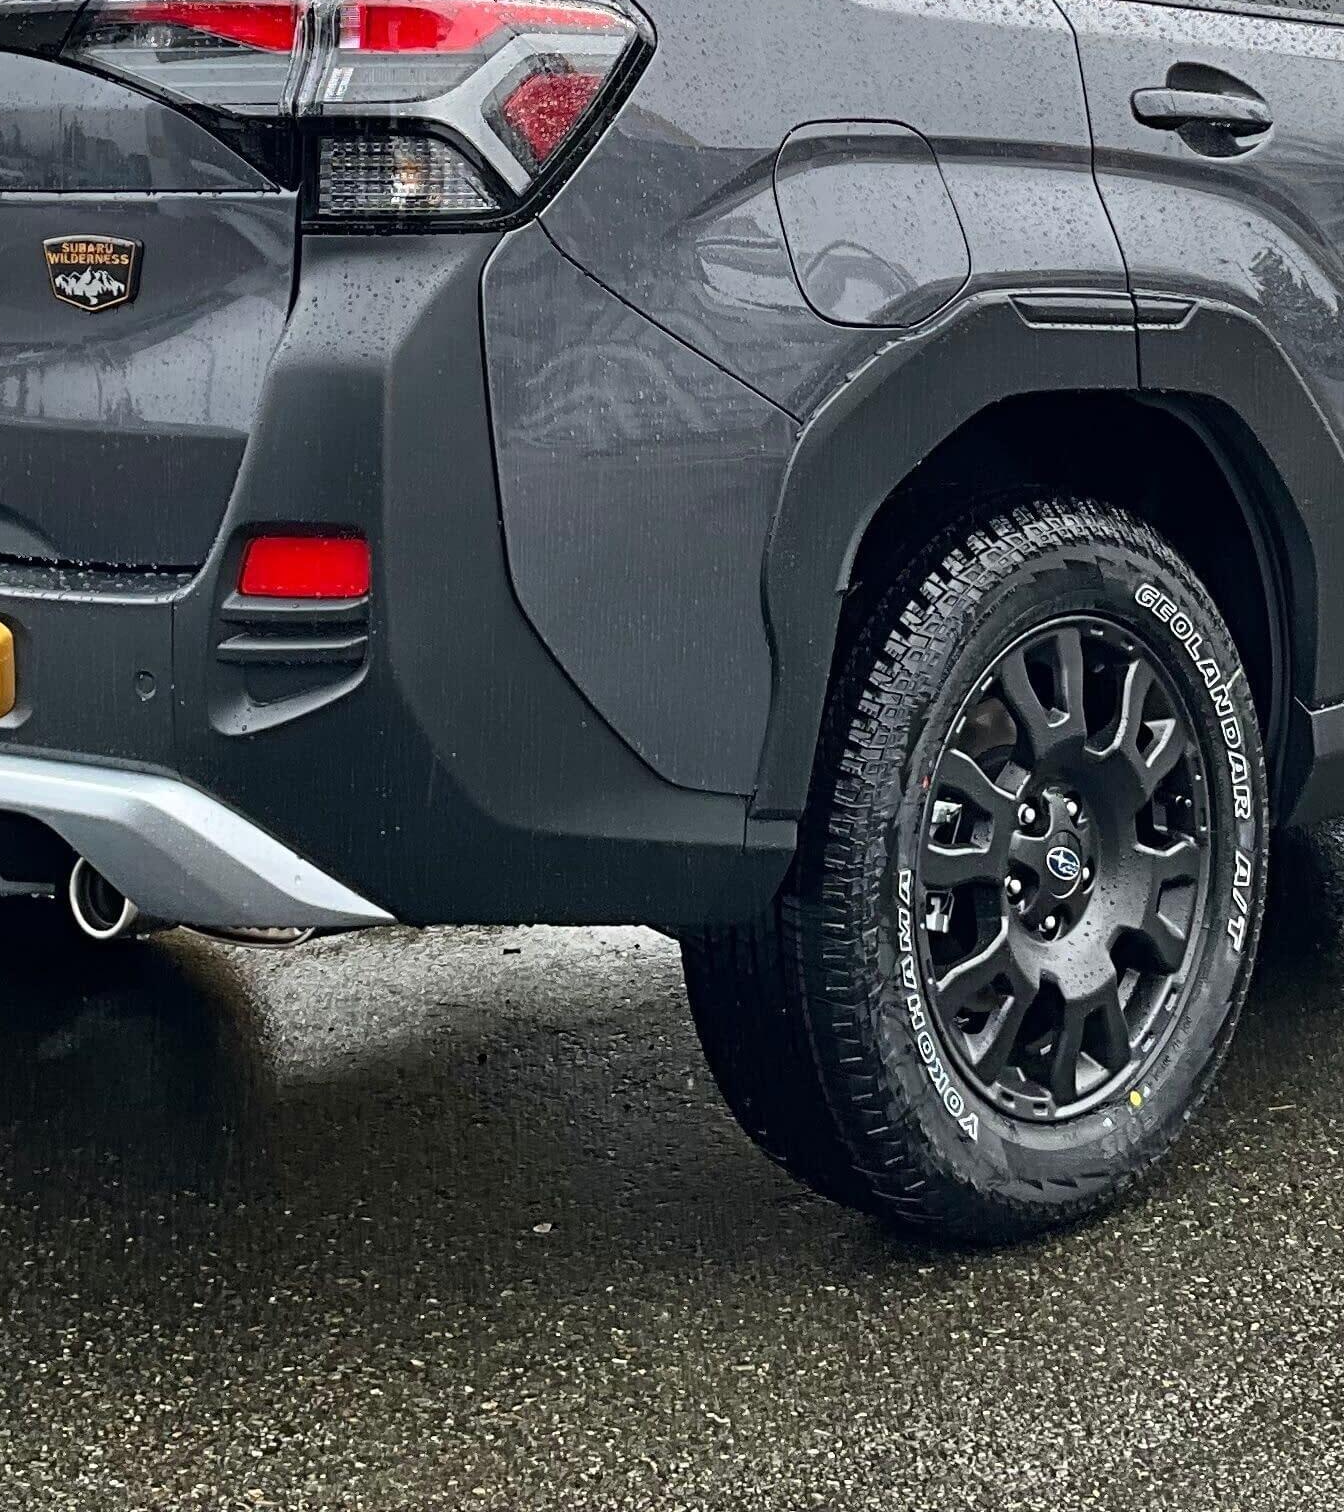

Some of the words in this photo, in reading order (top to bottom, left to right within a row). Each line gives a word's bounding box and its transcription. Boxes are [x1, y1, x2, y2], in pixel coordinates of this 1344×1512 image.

[47, 251, 130, 265] WILDERNESS
[61, 242, 114, 254] SUBARU
[1134, 582, 1251, 820] GEOLANDAR
[1227, 849, 1252, 952] A/T
[897, 869, 979, 1142] YOKOHAMA
